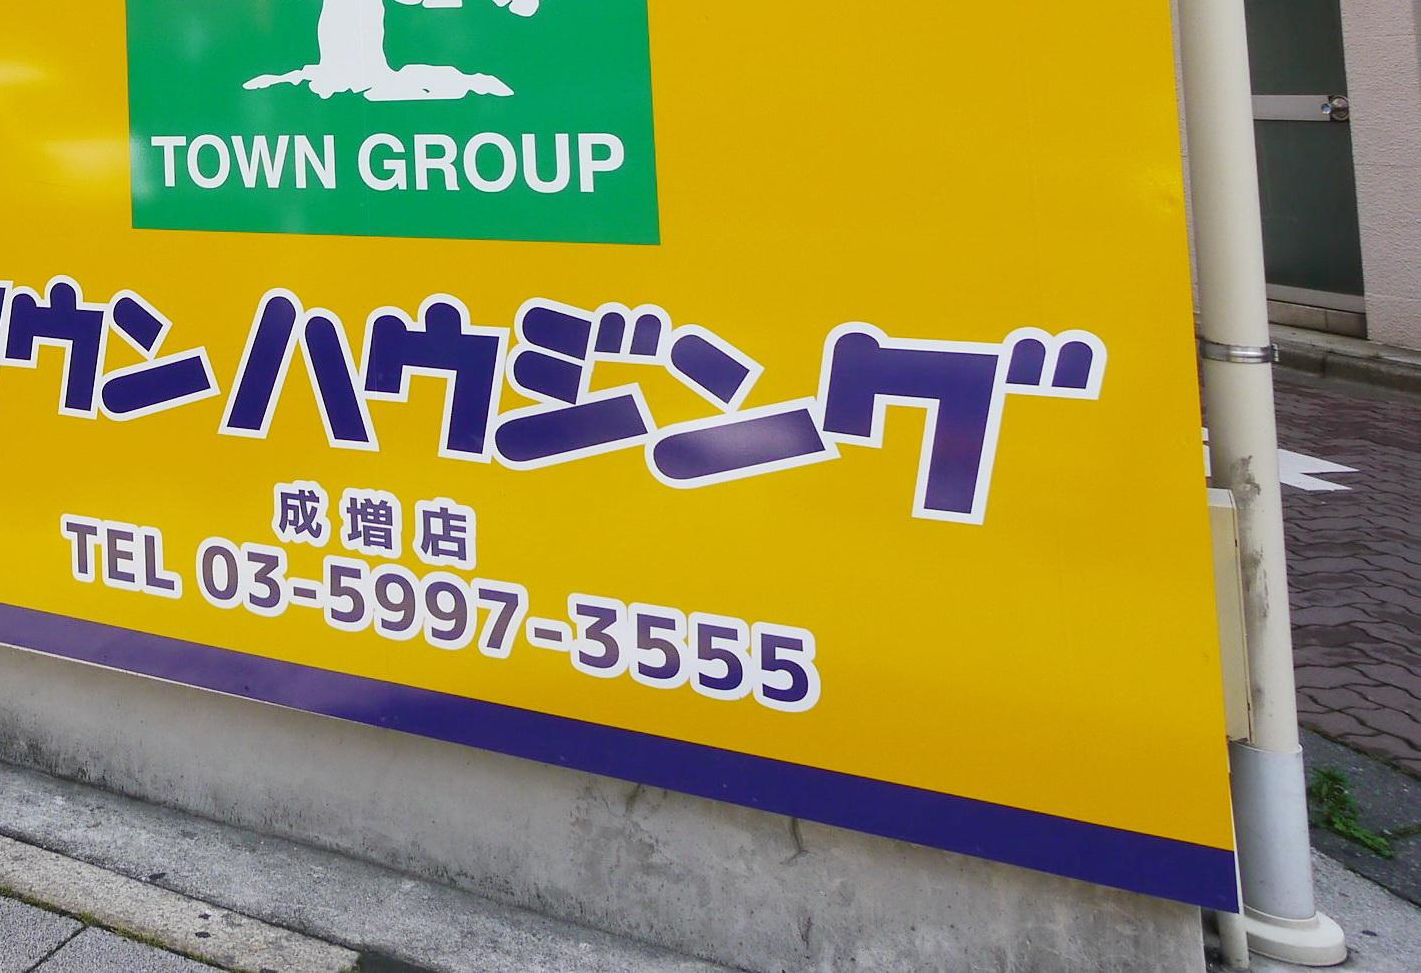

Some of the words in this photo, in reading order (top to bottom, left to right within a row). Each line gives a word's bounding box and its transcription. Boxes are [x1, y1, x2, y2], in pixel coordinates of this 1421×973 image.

[151, 132, 341, 190] TOWN
[357, 130, 626, 194] GROUP
[276, 489, 473, 559] 成増店
[65, 520, 176, 591] TEL
[202, 550, 814, 706] 03-5997-3555
